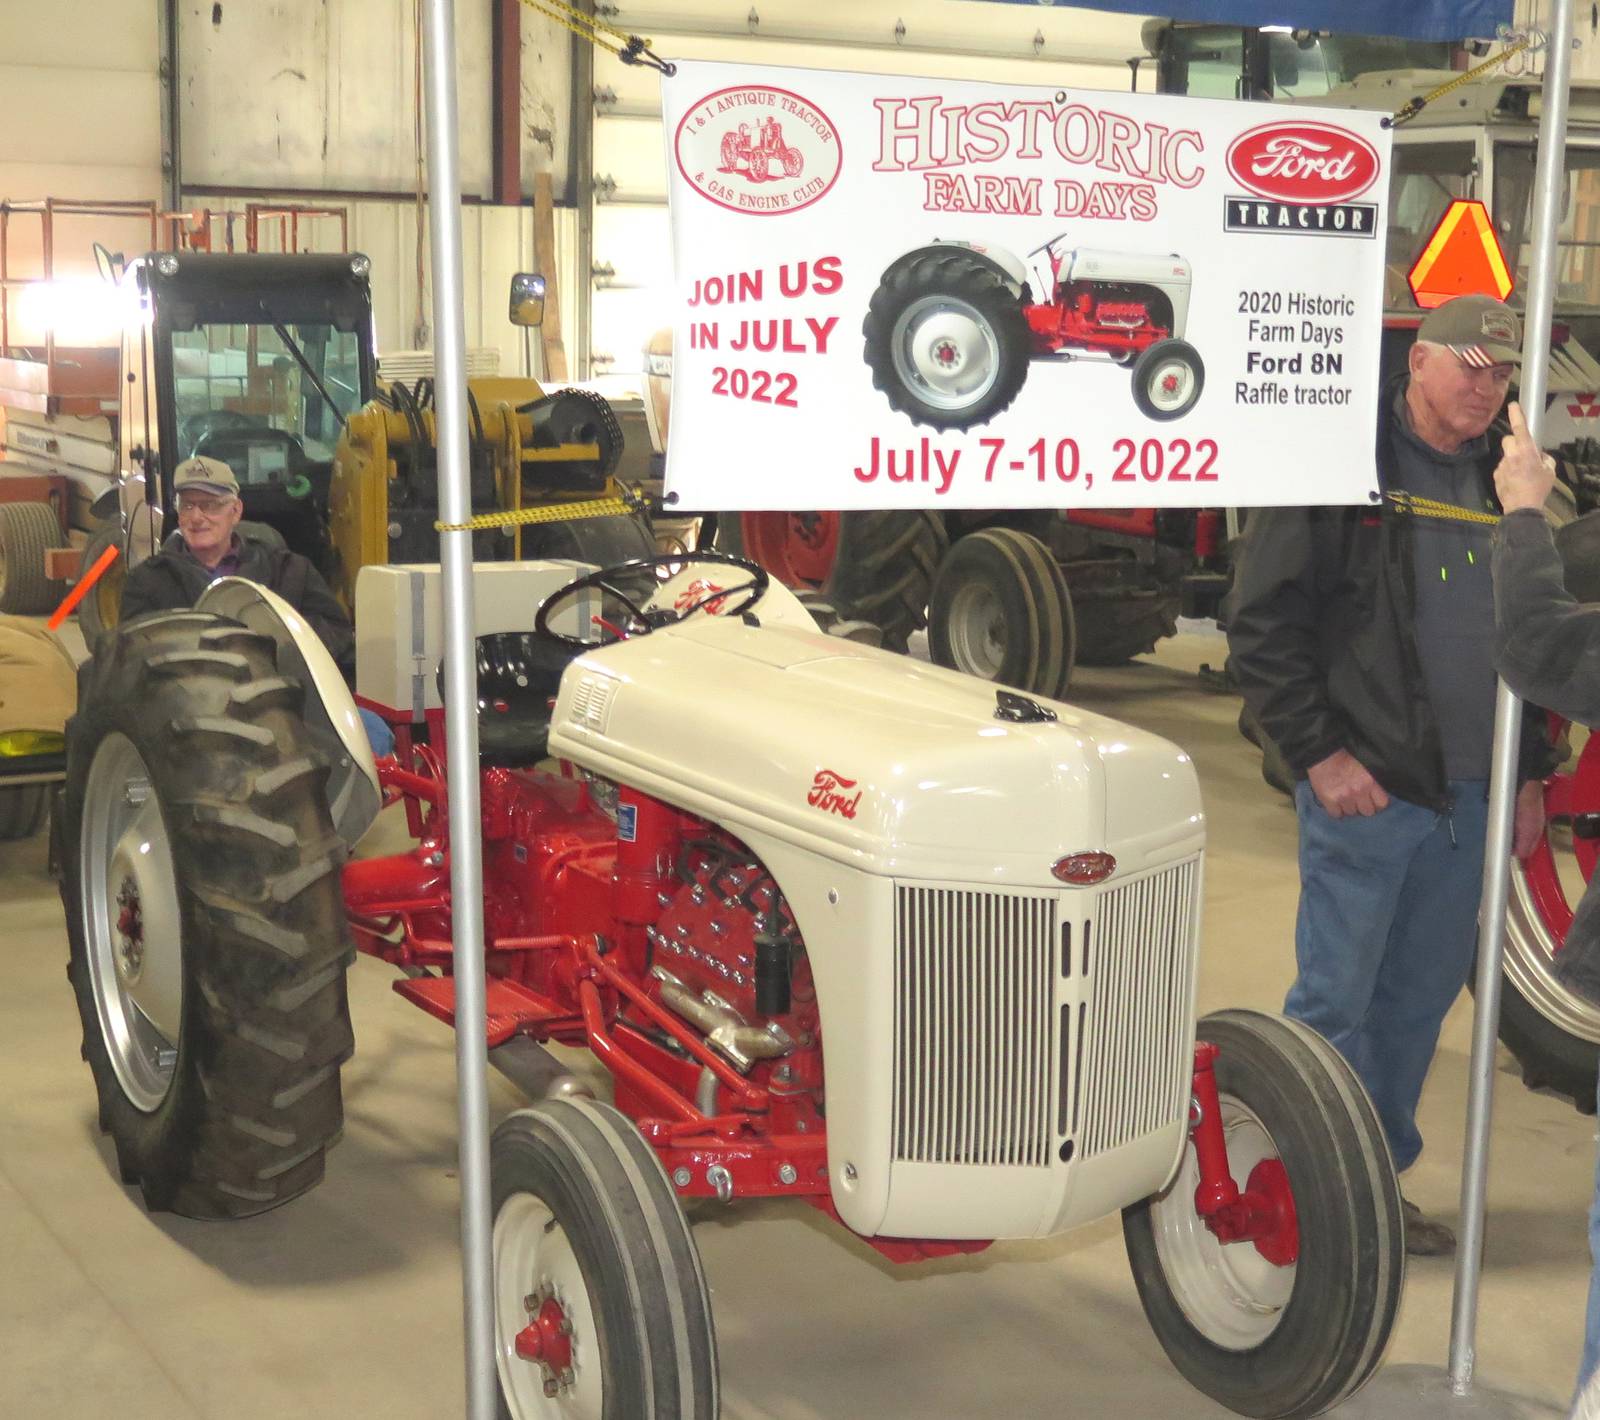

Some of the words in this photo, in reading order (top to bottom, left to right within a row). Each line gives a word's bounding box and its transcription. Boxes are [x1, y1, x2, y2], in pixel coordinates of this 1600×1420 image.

[695, 117, 706, 127] &
[716, 92, 777, 113] ANTIQUE
[780, 97, 833, 144] TRACTOR
[872, 96, 1205, 189] HISTORIC
[1252, 137, 1356, 182] Ford
[694, 171, 705, 183] &
[708, 180, 735, 202] GAS
[738, 192, 790, 209] ENGINE
[793, 176, 826, 202] CLUB
[923, 172, 1042, 216] FARM
[1054, 179, 1158, 221] DAYS
[1238, 203, 1363, 230] TRACTOR
[687, 269, 763, 307] JOIN
[779, 256, 844, 298] US
[1238, 291, 1282, 315] 2020
[1287, 292, 1355, 316] Historic
[690, 322, 719, 350] IN
[730, 316, 840, 354] JULY
[1248, 320, 1295, 343] Farm
[1301, 320, 1344, 349] Days
[1246, 352, 1302, 375] Ford
[1310, 352, 1343, 375] 8N
[711, 367, 798, 408] 2022
[1235, 382, 1289, 405] Raffle
[1294, 384, 1352, 405] tractor
[854, 437, 962, 495] July
[979, 438, 1094, 490] 7-10,
[1111, 438, 1219, 482] 2022
[807, 769, 862, 819] Ford
